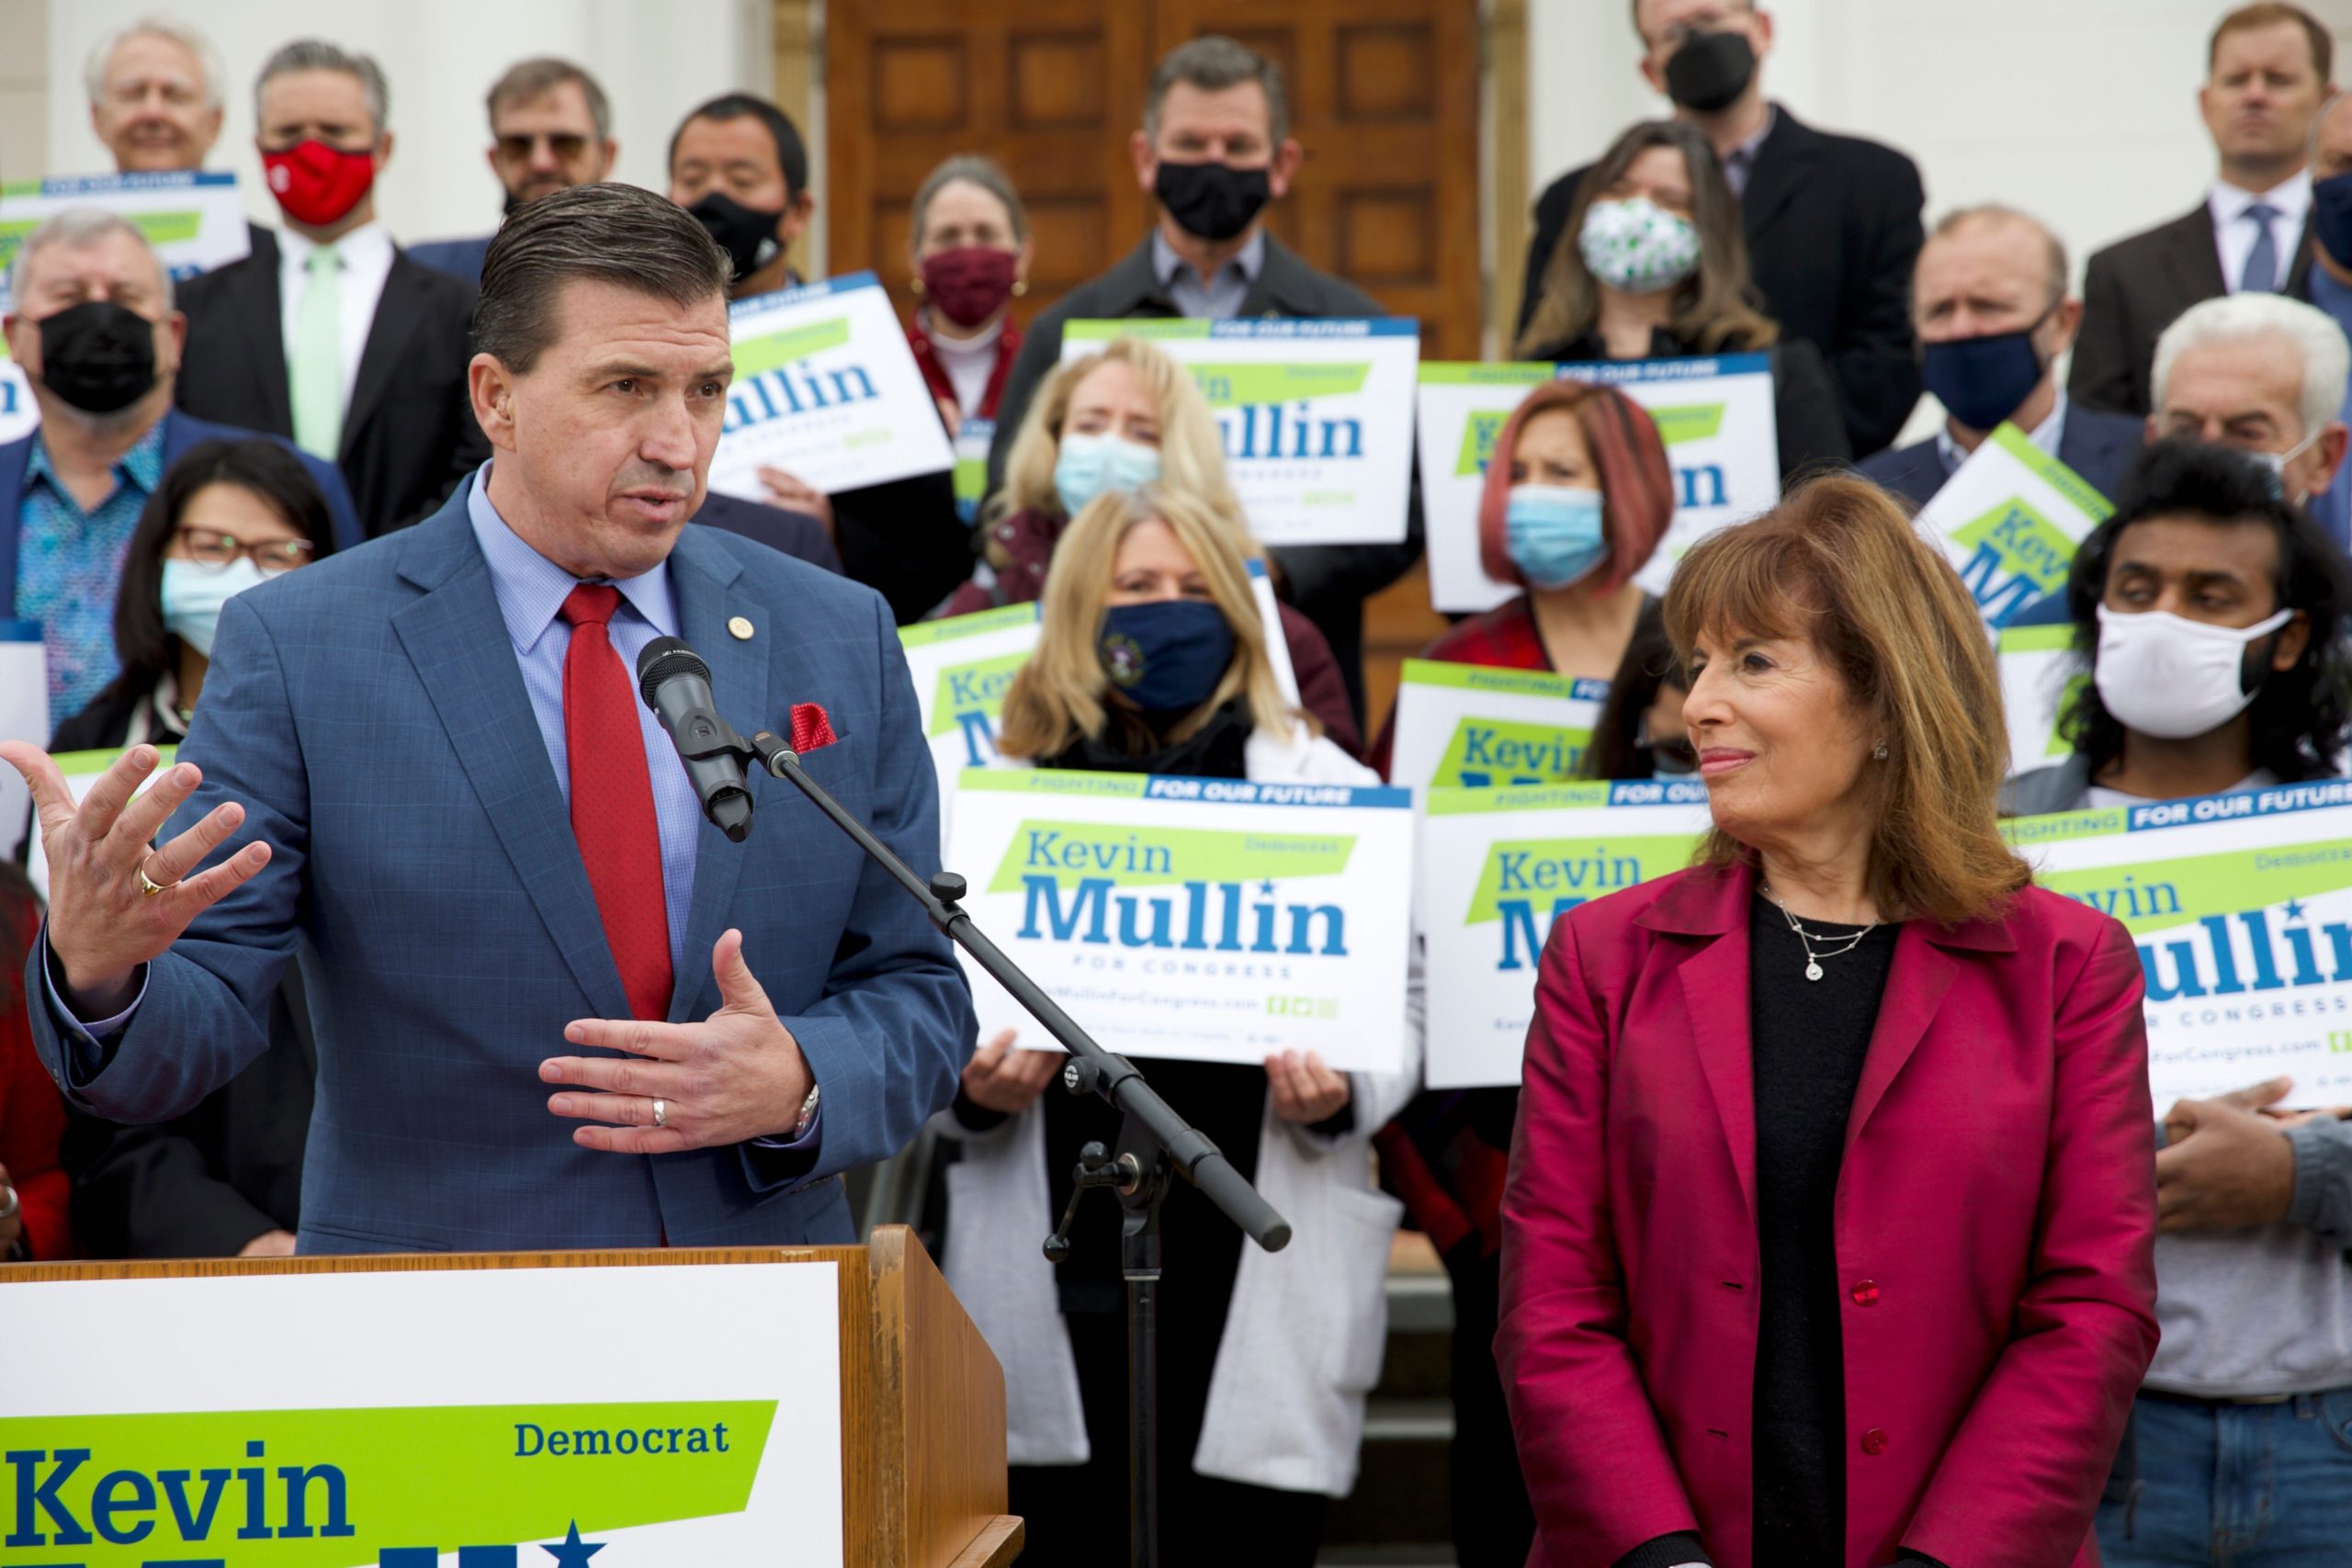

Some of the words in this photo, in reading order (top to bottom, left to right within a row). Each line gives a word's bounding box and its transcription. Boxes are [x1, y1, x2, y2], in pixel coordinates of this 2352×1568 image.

[721, 359, 879, 434] ullin
[1576, 682, 1609, 699] FO
[1150, 780, 1198, 799] FOR
[1204, 783, 1256, 802] OUR
[1261, 785, 1352, 806] FUTURE
[1613, 784, 1664, 804] FOR
[1667, 783, 1709, 802] OU
[2134, 804, 2188, 829] FOR
[2194, 795, 2254, 820] OUR
[1023, 829, 1172, 874] Kevin
[2255, 846, 2352, 874] Democra
[1497, 849, 1641, 892] Kevin
[1016, 874, 1349, 957] Mullin
[1073, 954, 1125, 971] FOR
[1144, 960, 1292, 980] CONGRESS
[2178, 996, 2347, 1027] CONGRESS
[5, 1440, 356, 1548] Kevin
[514, 1420, 730, 1458] Democrat
